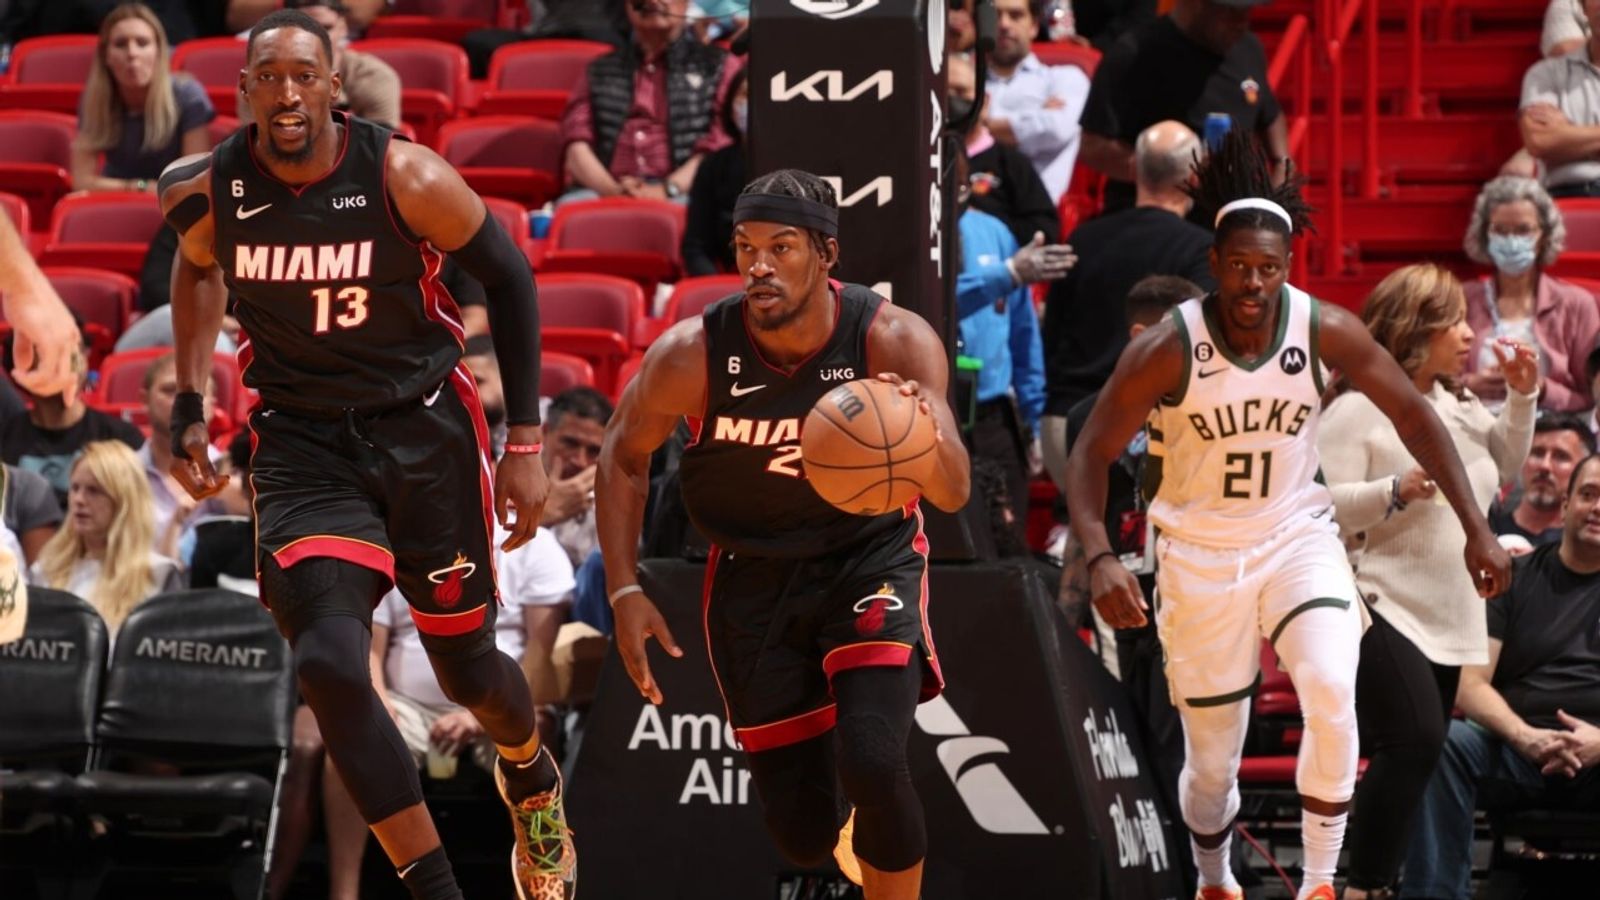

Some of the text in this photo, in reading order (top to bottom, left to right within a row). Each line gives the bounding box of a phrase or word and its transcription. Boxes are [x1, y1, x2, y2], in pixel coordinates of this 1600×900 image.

[771, 70, 893, 101] KIA
[231, 179, 244, 197] 6
[930, 89, 942, 278] AT&T
[332, 195, 367, 209] UKG
[234, 239, 374, 281] MIAMI
[310, 285, 369, 334] 13
[727, 356, 741, 374] 6
[1198, 345, 1209, 360] 6
[820, 367, 855, 381] UKG
[713, 415, 799, 446] MIA
[1188, 398, 1313, 441] BUCKS
[767, 444, 803, 479] 2
[1223, 451, 1272, 499] 21
[136, 637, 267, 668] AMERANT
